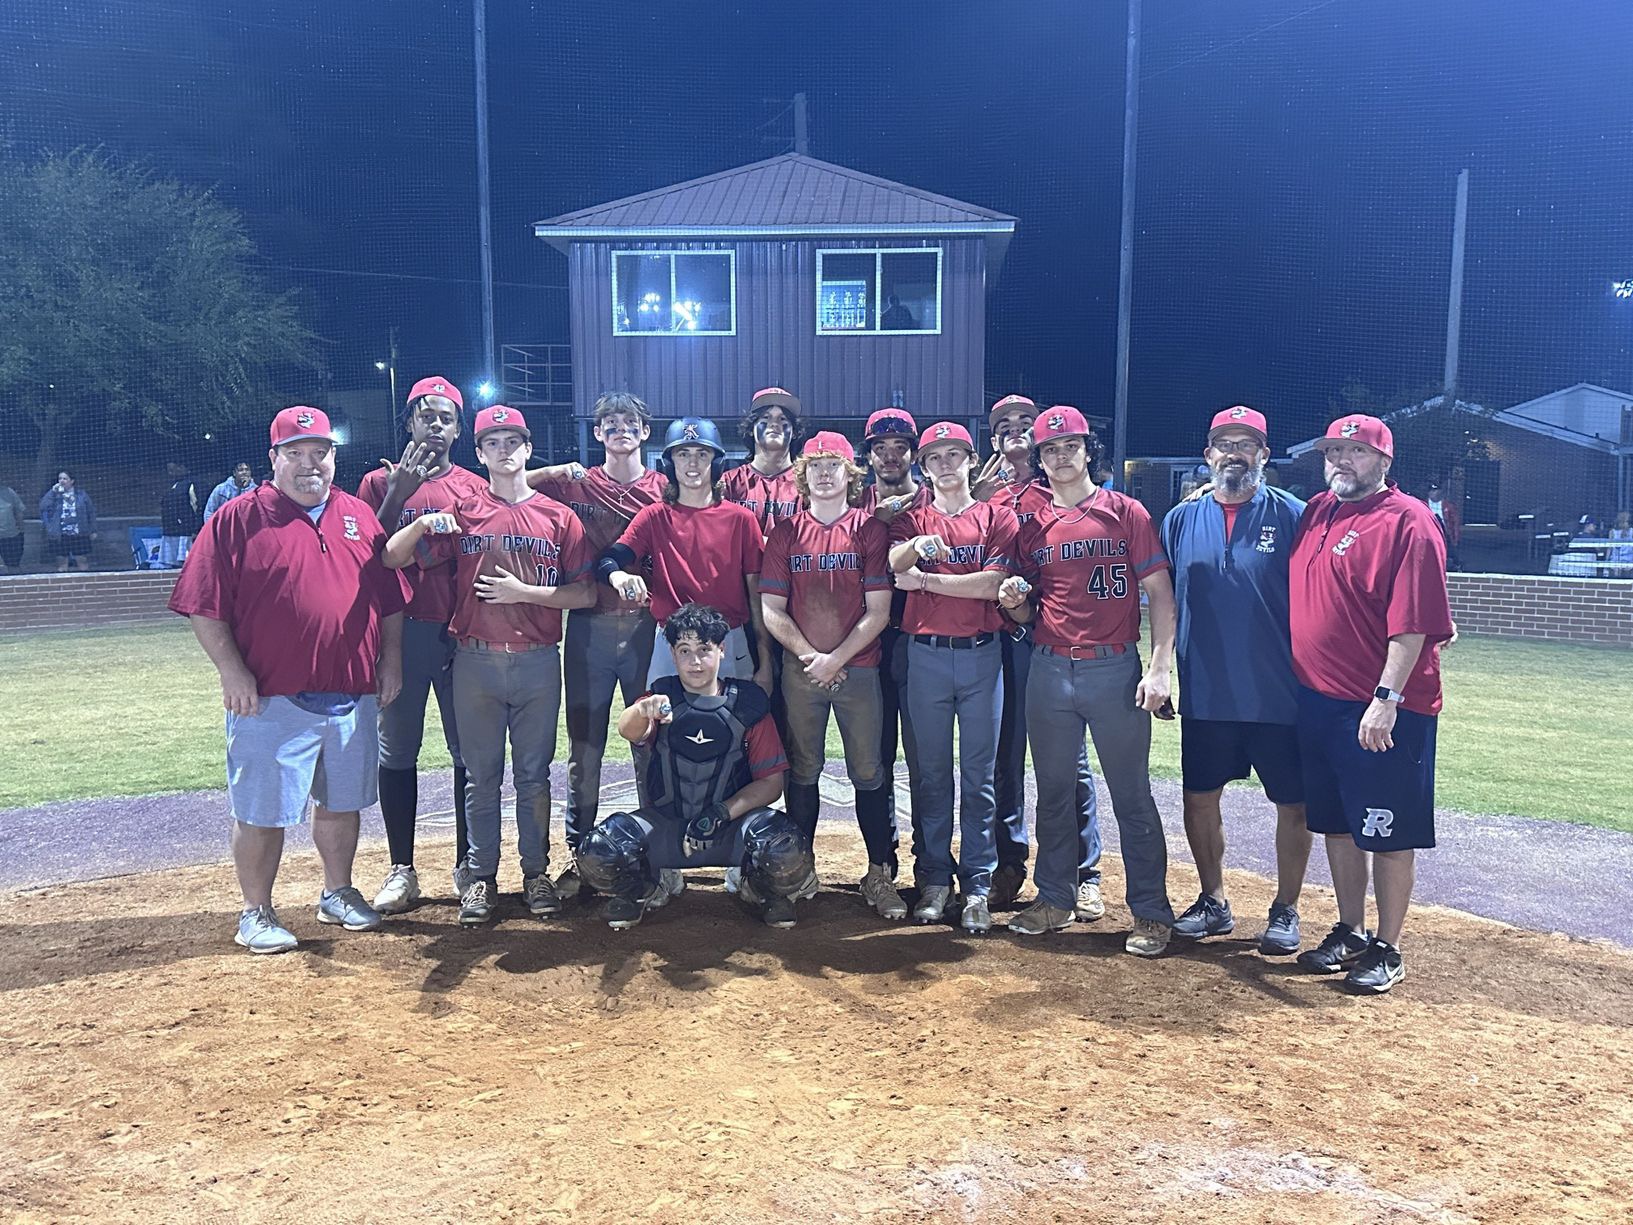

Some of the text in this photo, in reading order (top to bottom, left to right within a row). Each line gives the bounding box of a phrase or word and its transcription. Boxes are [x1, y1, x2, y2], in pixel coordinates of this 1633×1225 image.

[460, 534, 560, 560] DIRT DEVILS
[1060, 538, 1127, 561] DEVILS
[1087, 564, 1128, 600] 45
[1362, 808, 1394, 837] R
